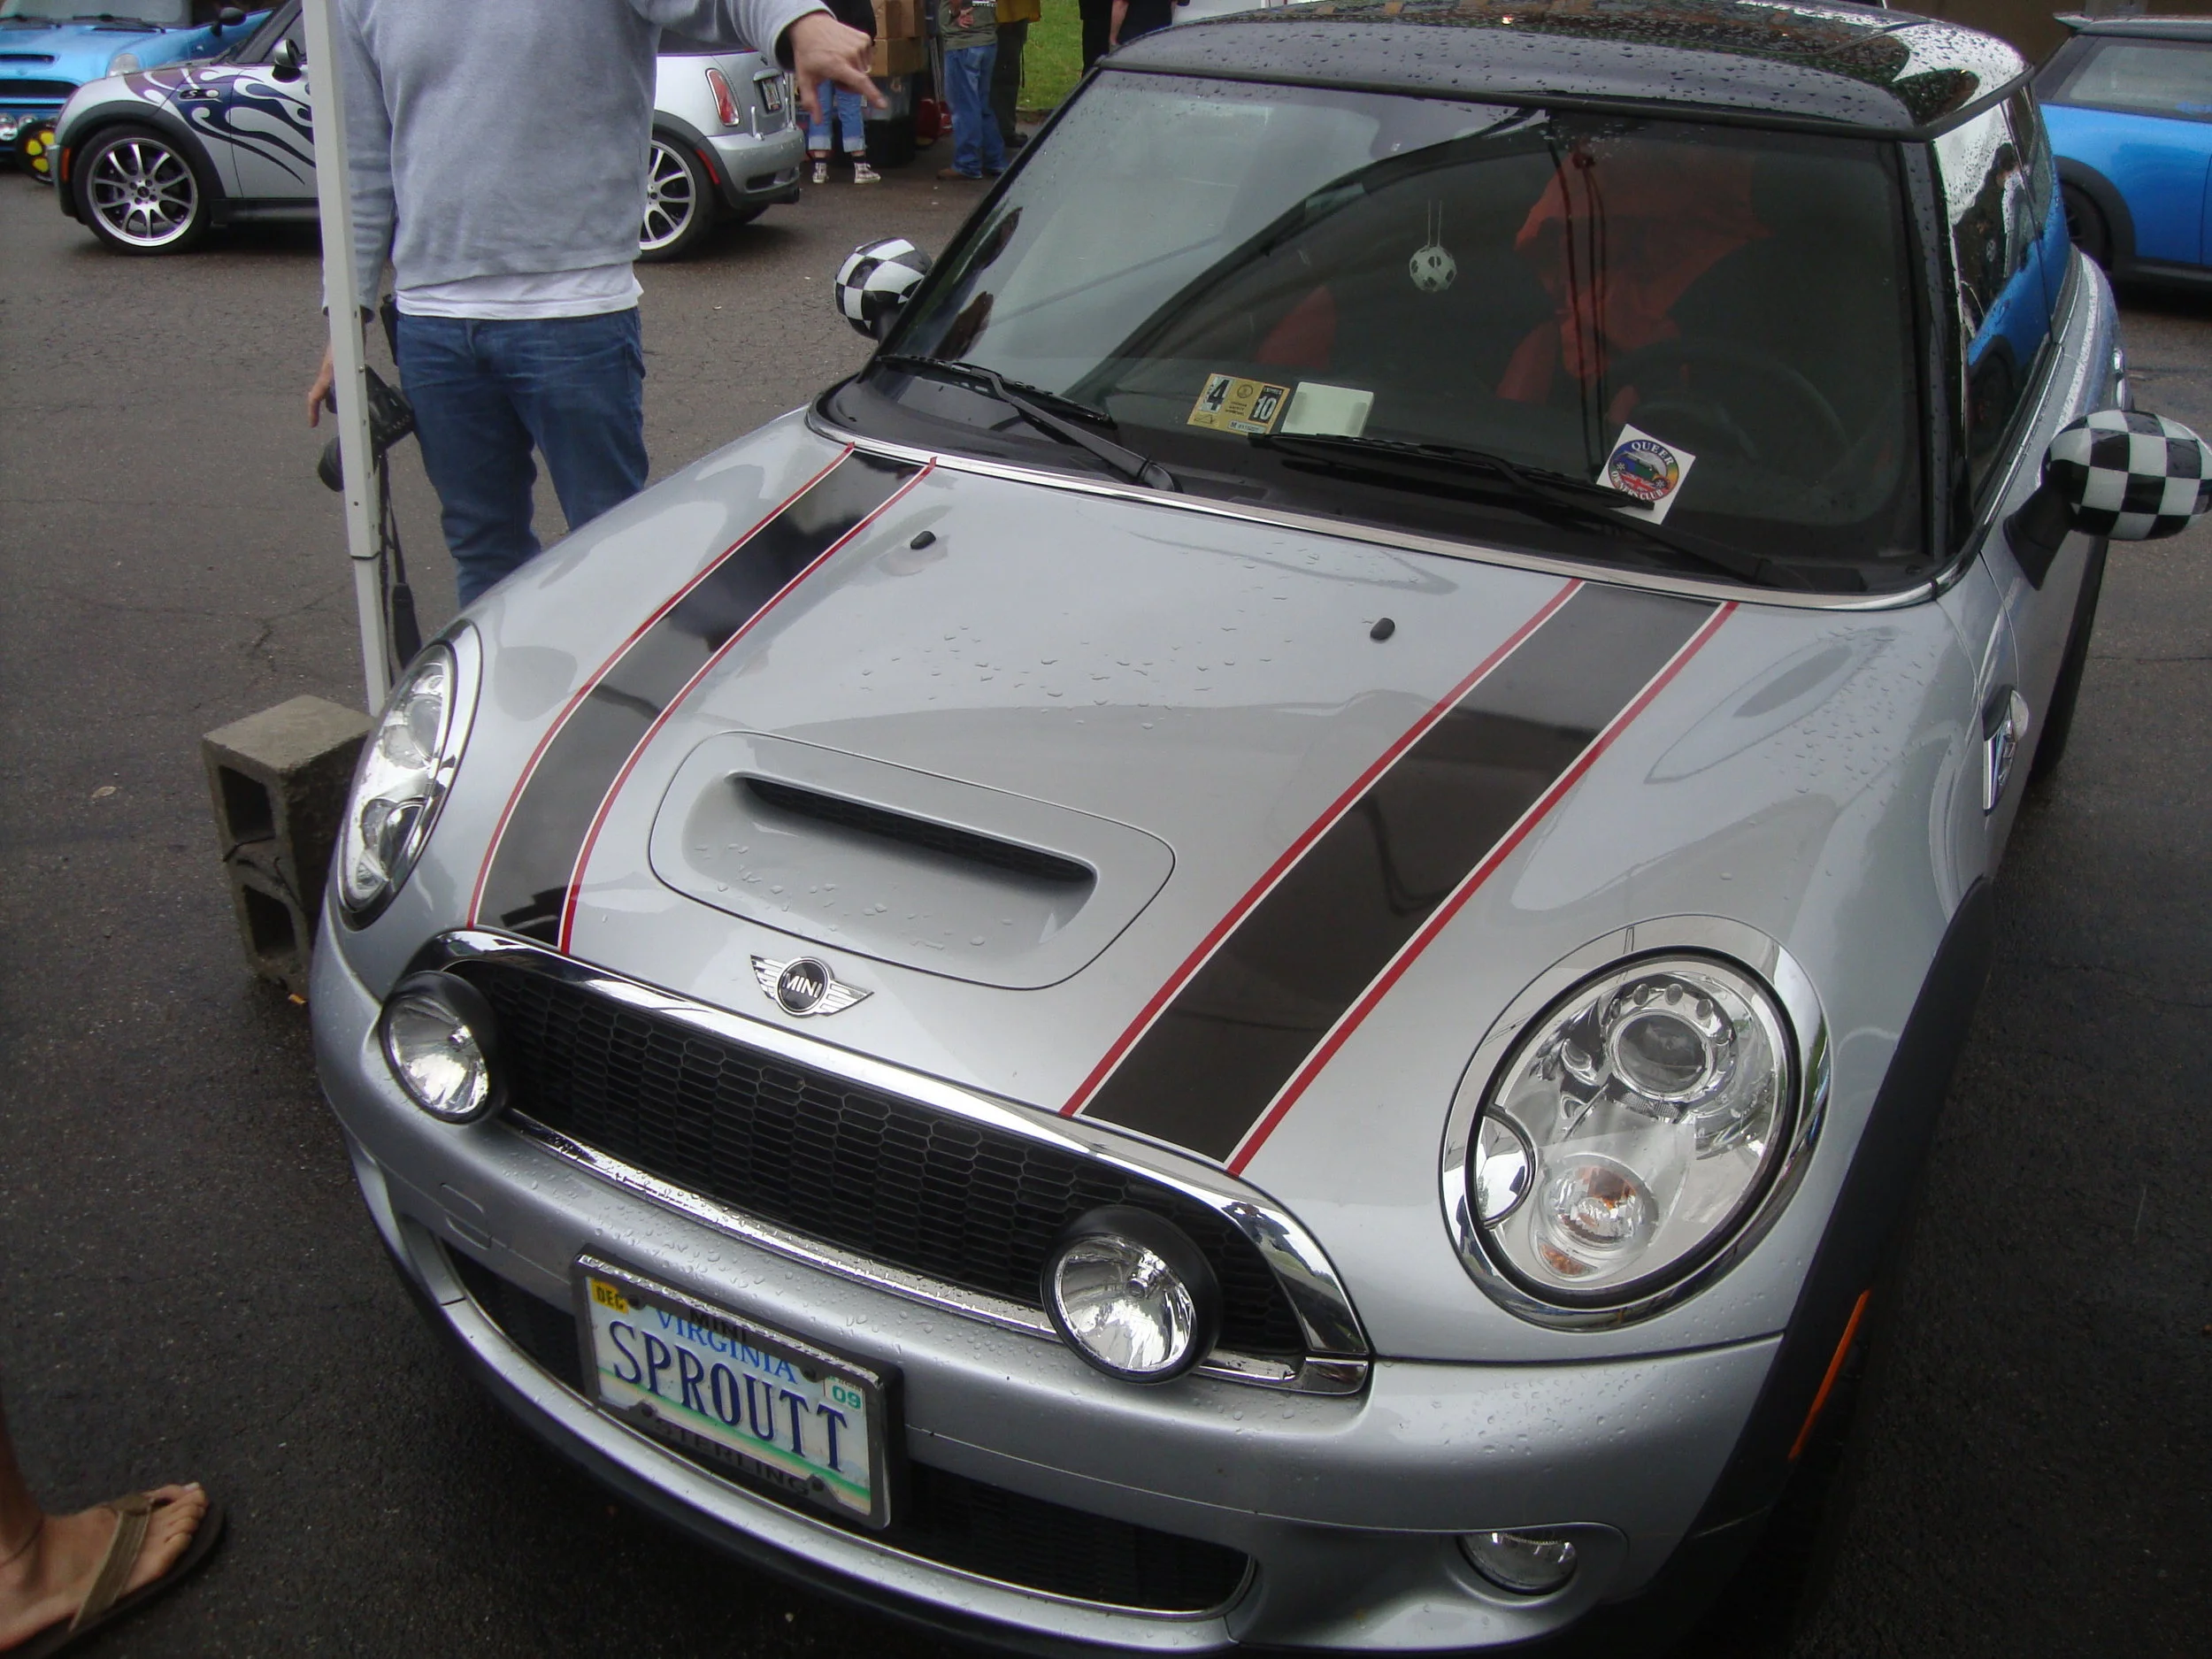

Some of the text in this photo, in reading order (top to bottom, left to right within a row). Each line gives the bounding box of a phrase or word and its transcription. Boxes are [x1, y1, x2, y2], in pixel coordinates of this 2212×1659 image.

[1206, 379, 1231, 411] 4
[1253, 396, 1277, 420] 10
[1631, 441, 1674, 465] QUEER
[1640, 488, 1663, 500] CLUB
[782, 972, 823, 998] MINI
[596, 1286, 624, 1310] DEC
[689, 1308, 747, 1342] MINI
[656, 1310, 797, 1384] VIRGINIA
[609, 1320, 849, 1472] SPROUTT
[832, 1385, 861, 1409] 09
[655, 1417, 810, 1496] STERLING
